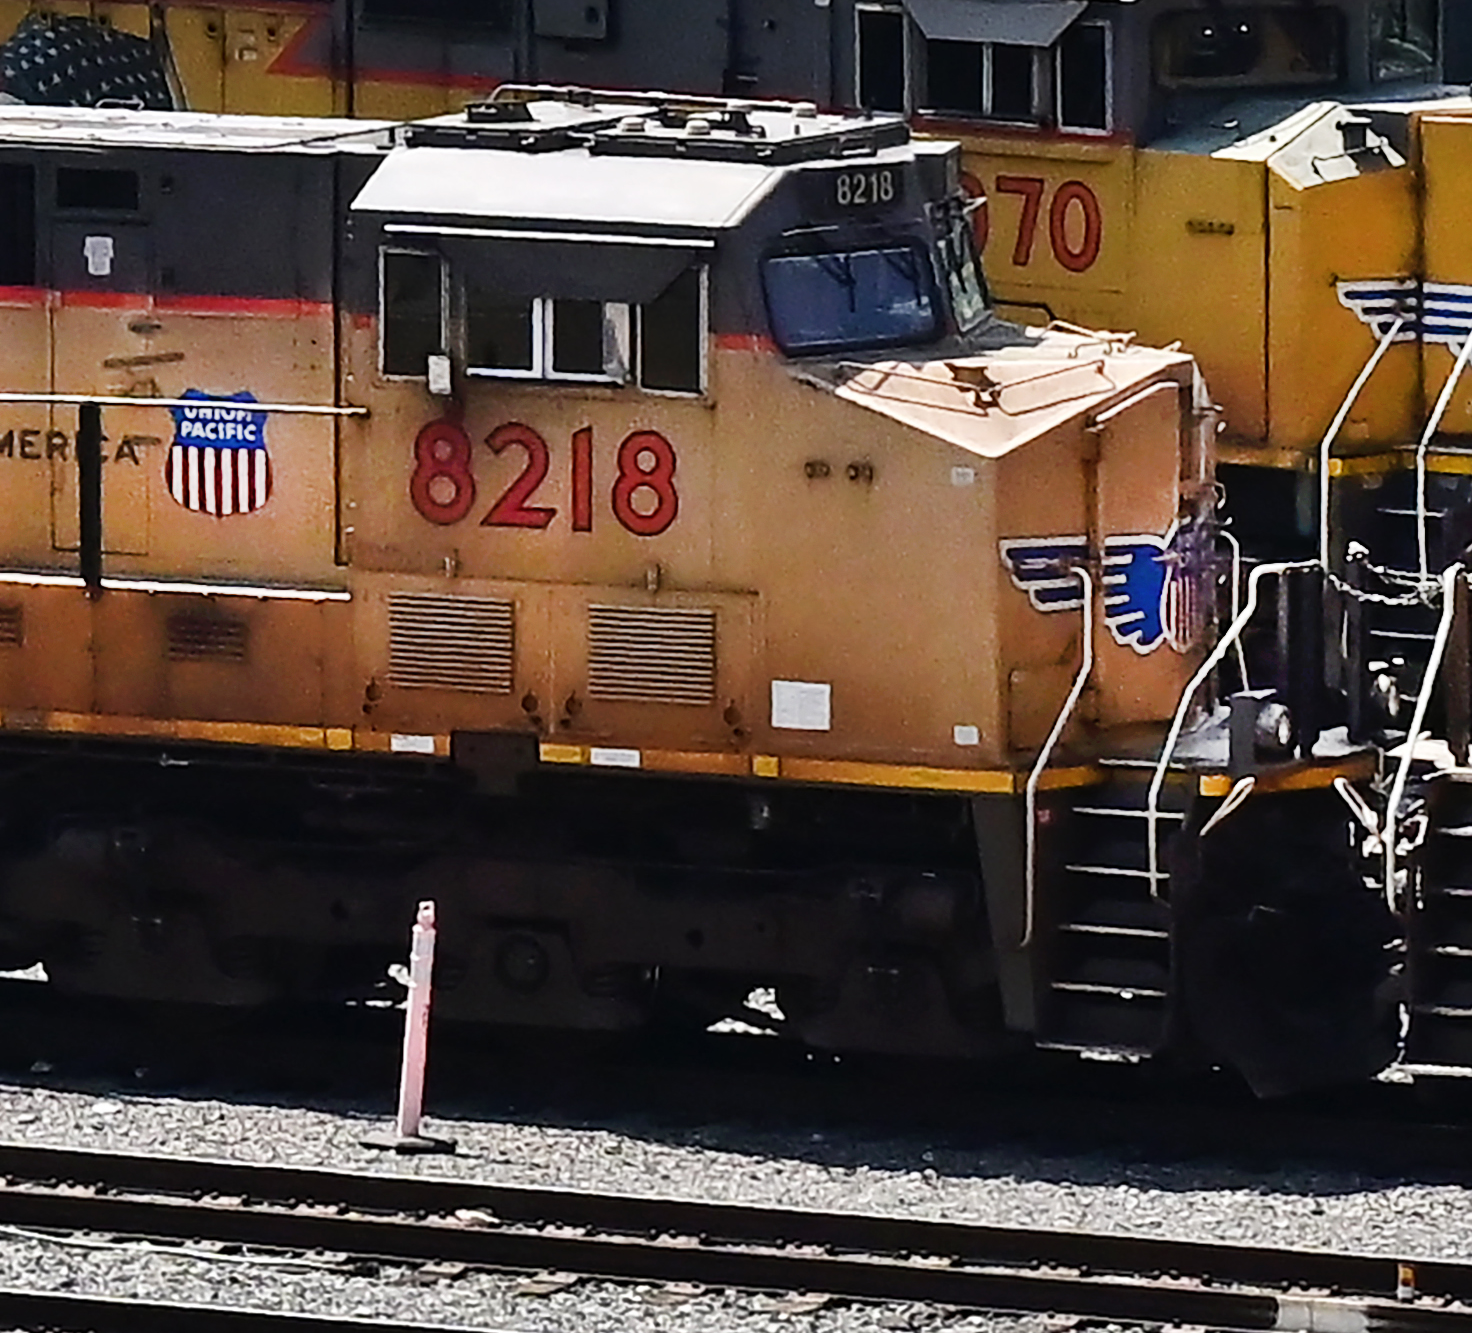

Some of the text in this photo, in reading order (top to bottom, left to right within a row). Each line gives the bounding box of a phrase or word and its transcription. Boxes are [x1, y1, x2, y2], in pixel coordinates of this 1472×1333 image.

[836, 170, 895, 205] 8218
[179, 419, 257, 442] PACIFIC
[409, 420, 680, 538] 8218
